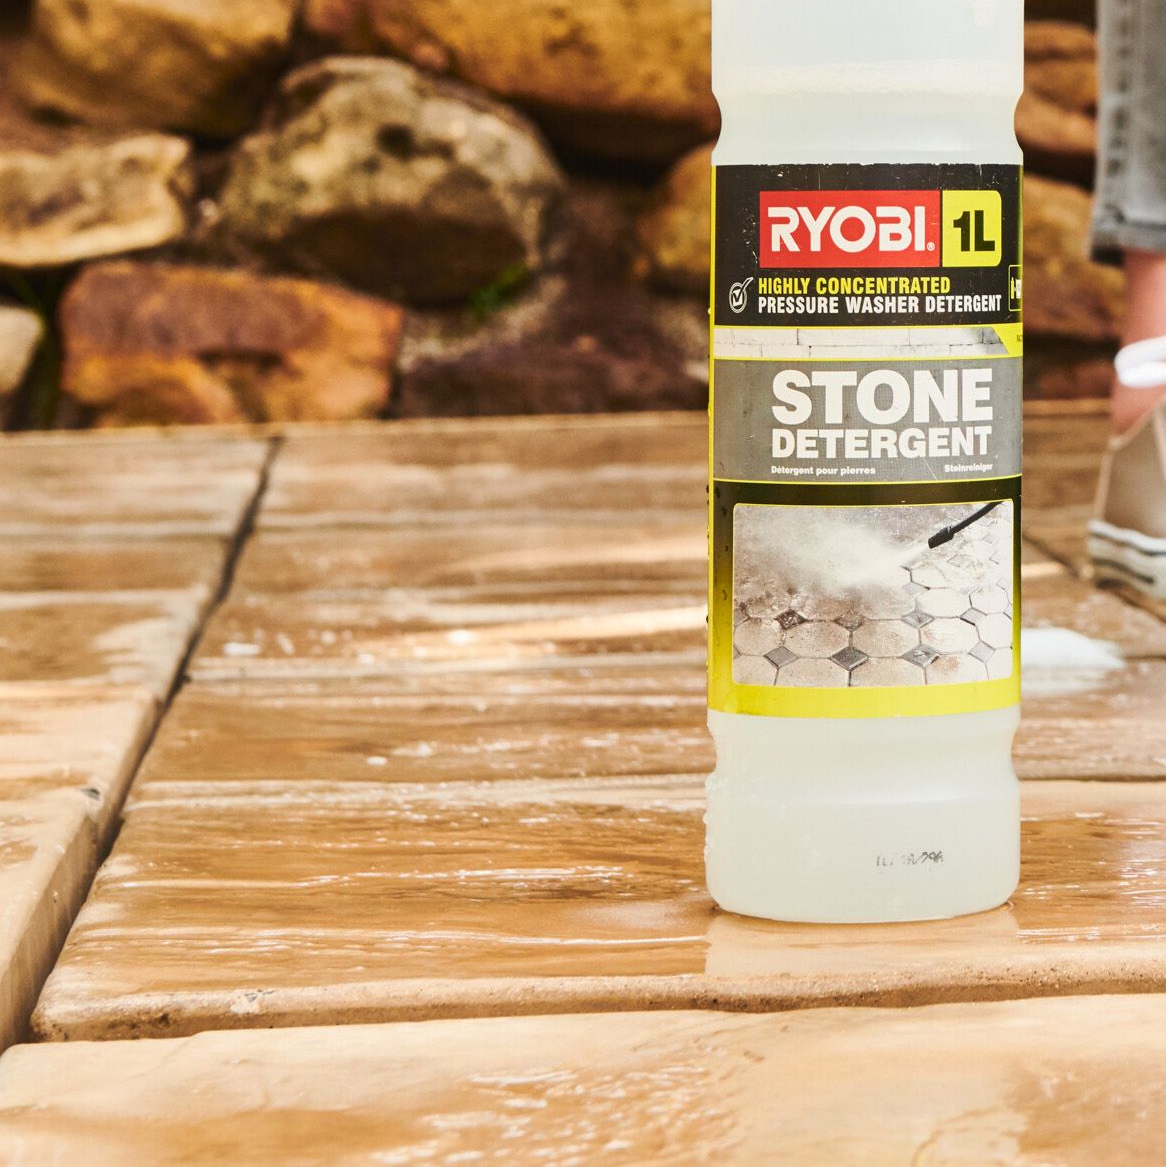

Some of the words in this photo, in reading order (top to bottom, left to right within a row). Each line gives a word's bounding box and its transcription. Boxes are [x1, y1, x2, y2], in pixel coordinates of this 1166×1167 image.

[953, 209, 996, 252] 1L
[758, 277, 810, 295] HIGHLY
[816, 276, 951, 295] CONCENTRATED
[758, 295, 839, 314] PRESSURE
[845, 295, 919, 314] WASHER
[925, 294, 1002, 313] DETERGENT
[771, 368, 993, 425] STONE
[772, 425, 992, 459] DETERGENT
[770, 465, 814, 476] Détergent
[815, 466, 838, 477] pour
[840, 466, 876, 477] pierres
[944, 462, 993, 473] Steinreiniger
